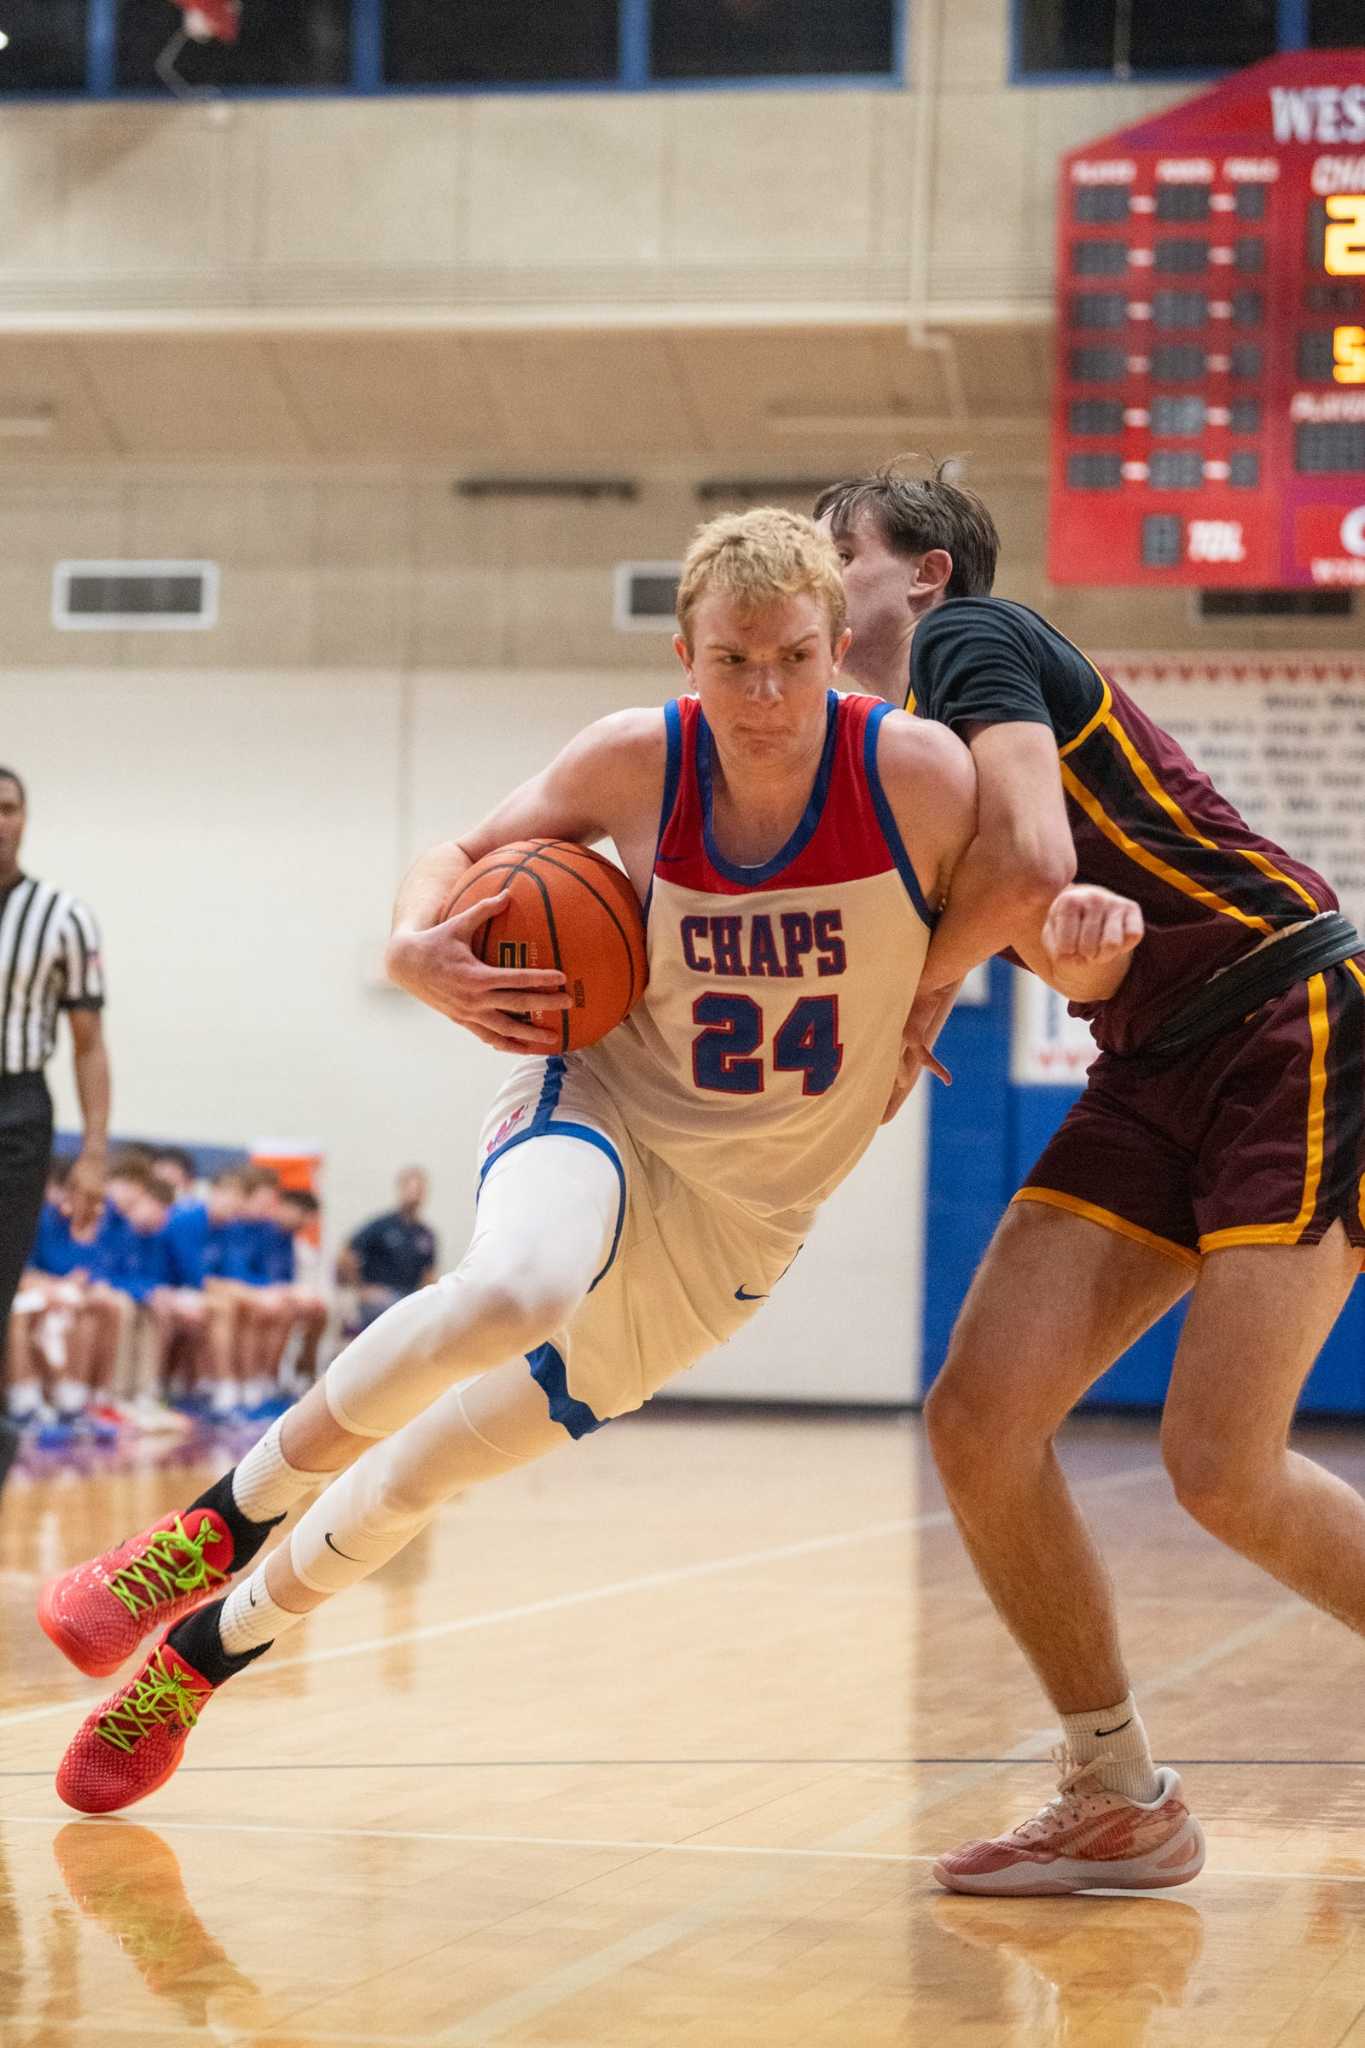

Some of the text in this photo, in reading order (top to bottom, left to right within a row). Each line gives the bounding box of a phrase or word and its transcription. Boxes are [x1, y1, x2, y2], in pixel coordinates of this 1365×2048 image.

[1269, 86, 1365, 144] WES
[1323, 194, 1365, 277] 2
[680, 909, 847, 978] CHAPS
[691, 991, 844, 1096] 24
